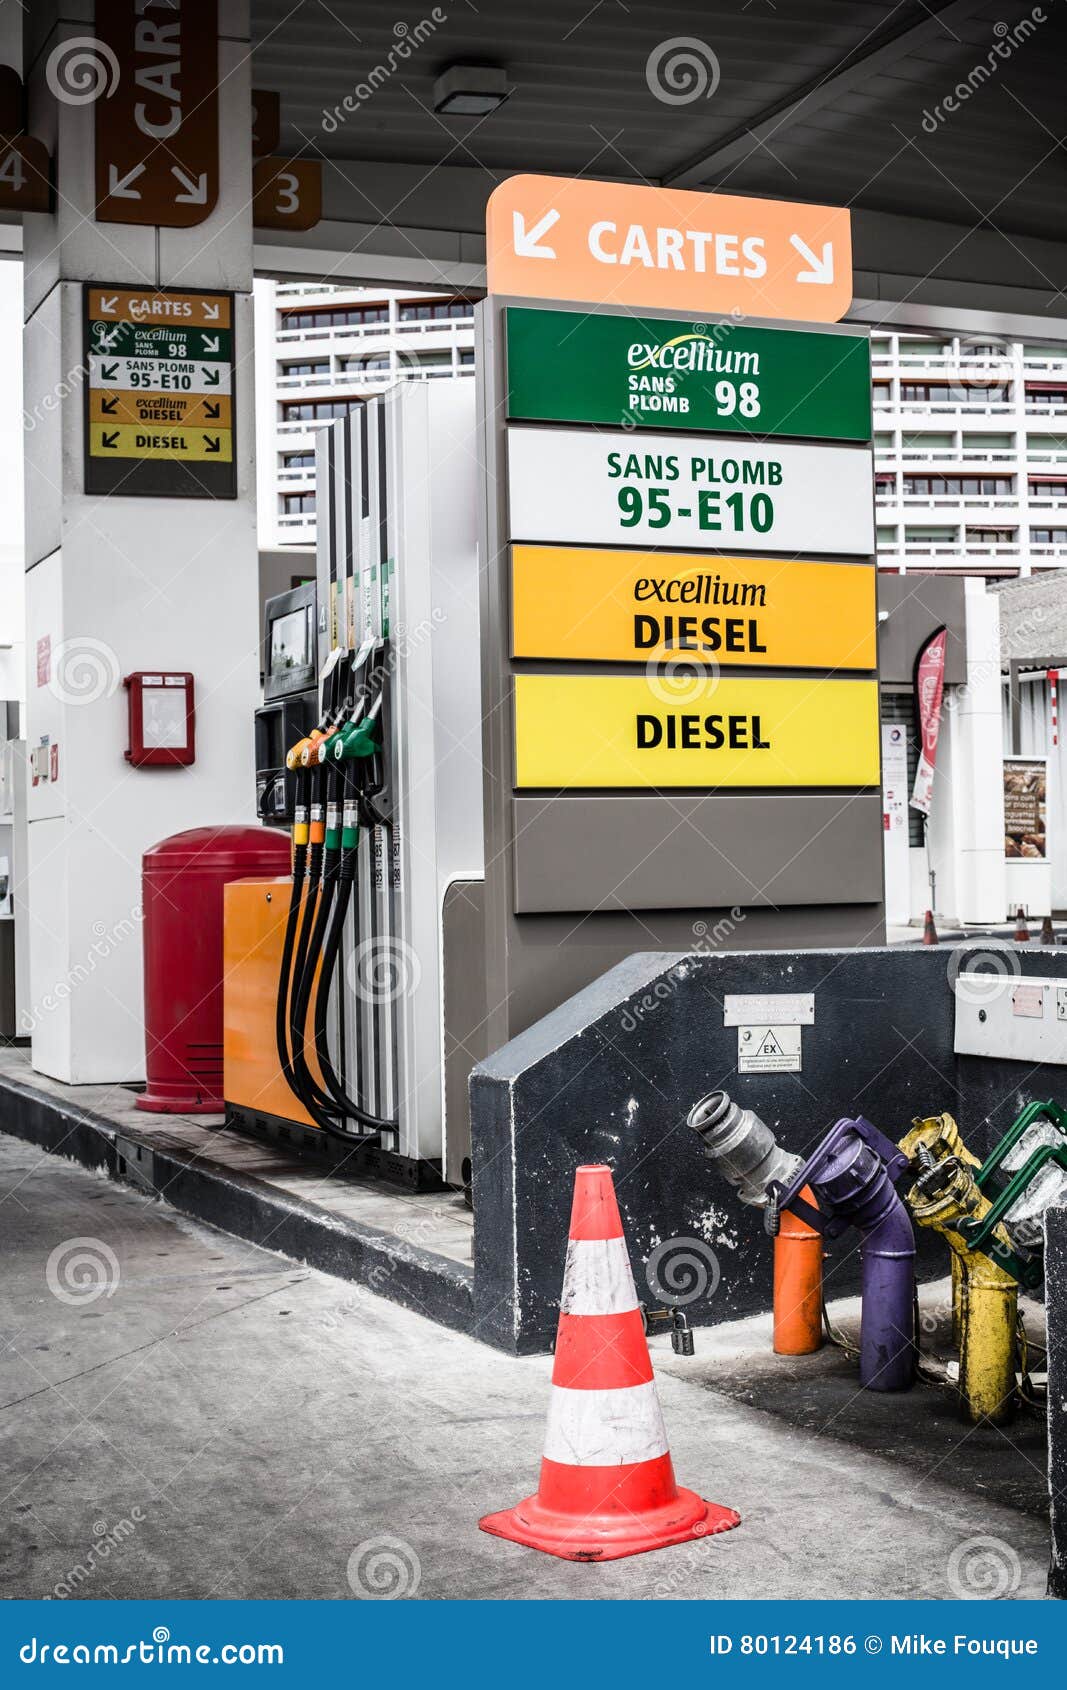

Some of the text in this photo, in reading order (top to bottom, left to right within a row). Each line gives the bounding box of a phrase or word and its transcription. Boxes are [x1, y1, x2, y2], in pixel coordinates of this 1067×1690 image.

[0, 150, 27, 192] 4
[275, 173, 301, 214] 3
[588, 221, 768, 279] CARTES
[128, 299, 193, 317] CARTES
[135, 328, 188, 342] excellium
[135, 342, 188, 358] SANS 98
[627, 341, 760, 376] excellium
[126, 360, 196, 374] SANS PLOMB
[130, 373, 192, 390] 95-E10
[136, 397, 187, 409] excellium
[628, 375, 761, 418] SANS 98
[629, 394, 690, 413] PLOMB
[139, 409, 183, 421] DIESEL
[135, 435, 188, 450] DIESEL
[607, 452, 783, 486] SANS PLOMB
[617, 486, 774, 533] 95-E10
[633, 575, 767, 607] excellium
[633, 614, 767, 653] DIESEL
[636, 714, 771, 750] DIESEL
[764, 1044, 777, 1054] EX
